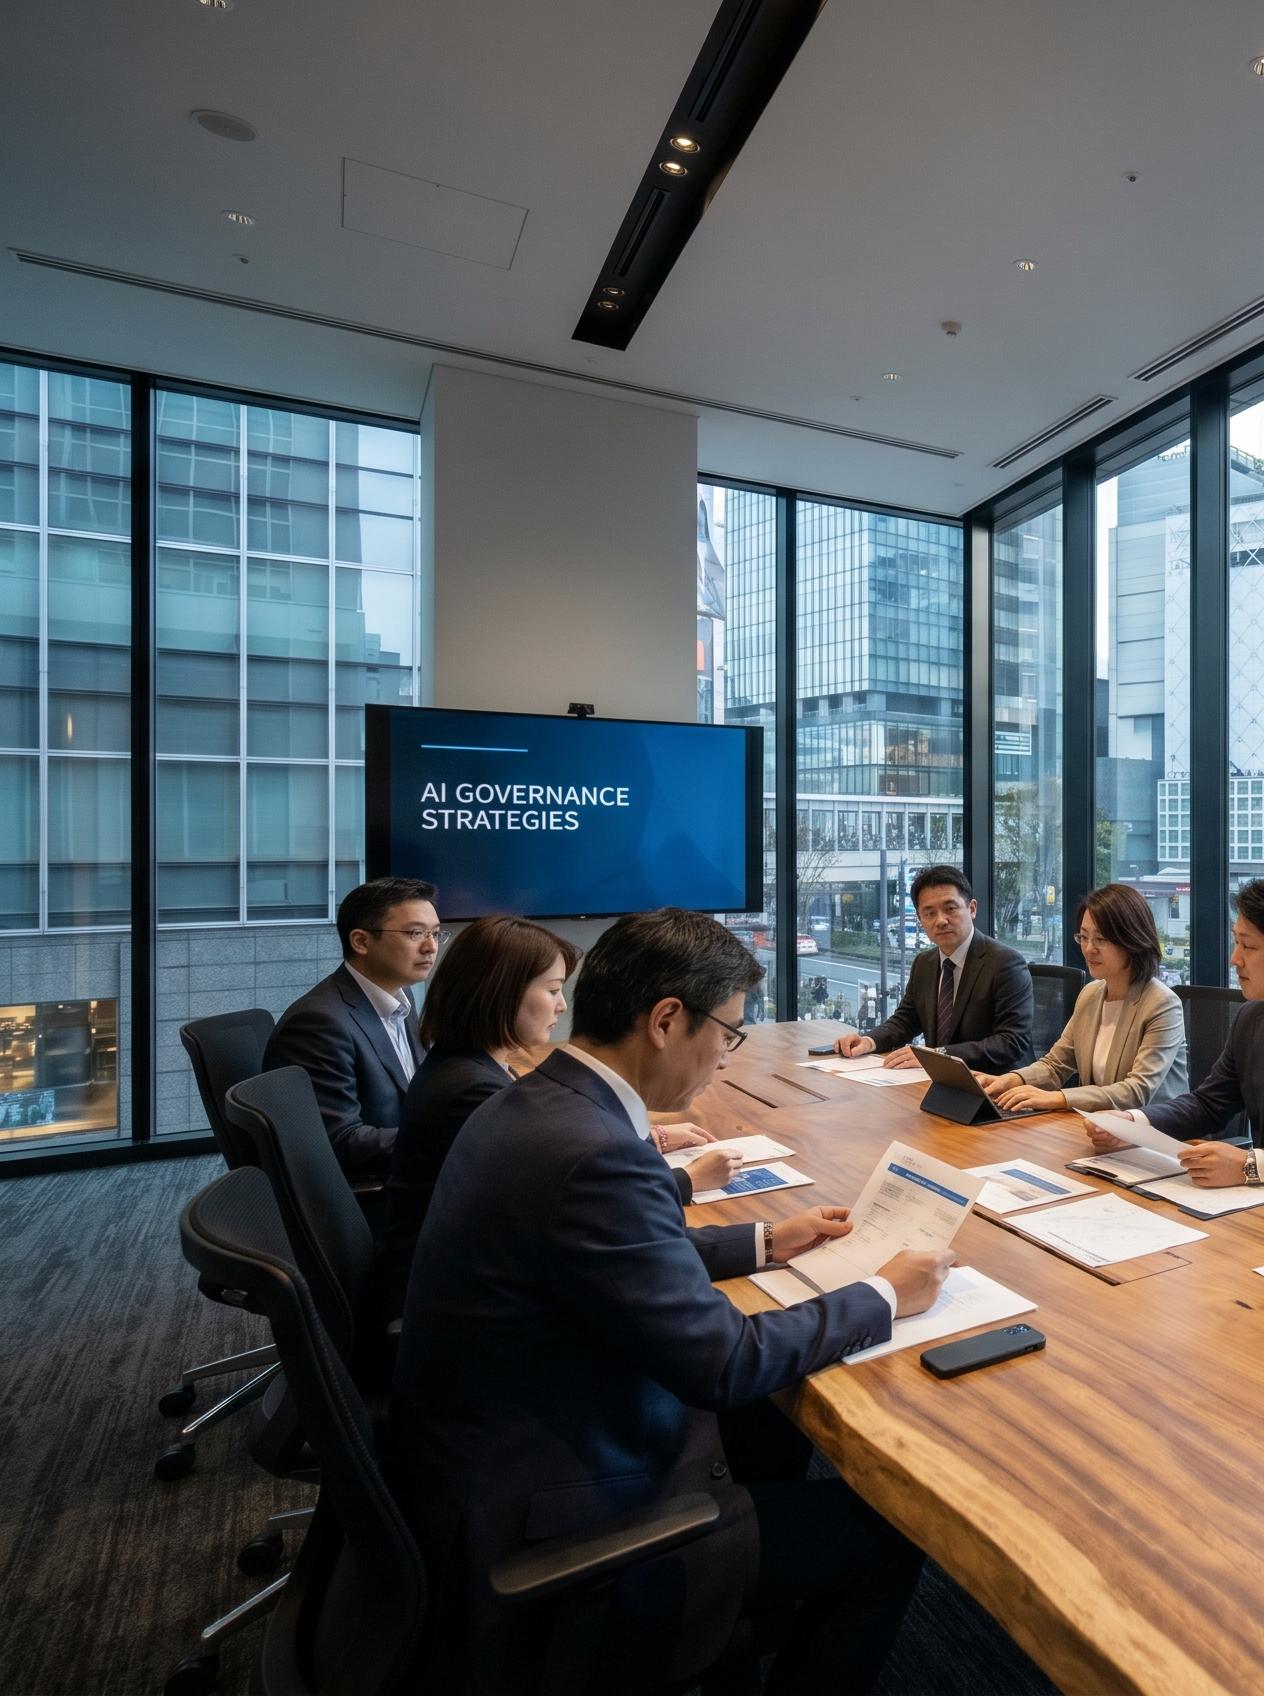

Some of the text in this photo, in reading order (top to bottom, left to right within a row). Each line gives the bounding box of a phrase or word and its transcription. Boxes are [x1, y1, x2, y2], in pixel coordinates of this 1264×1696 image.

[421, 782, 630, 806] AI GOVERNANCE
[421, 809, 580, 831] STRATEGIES
